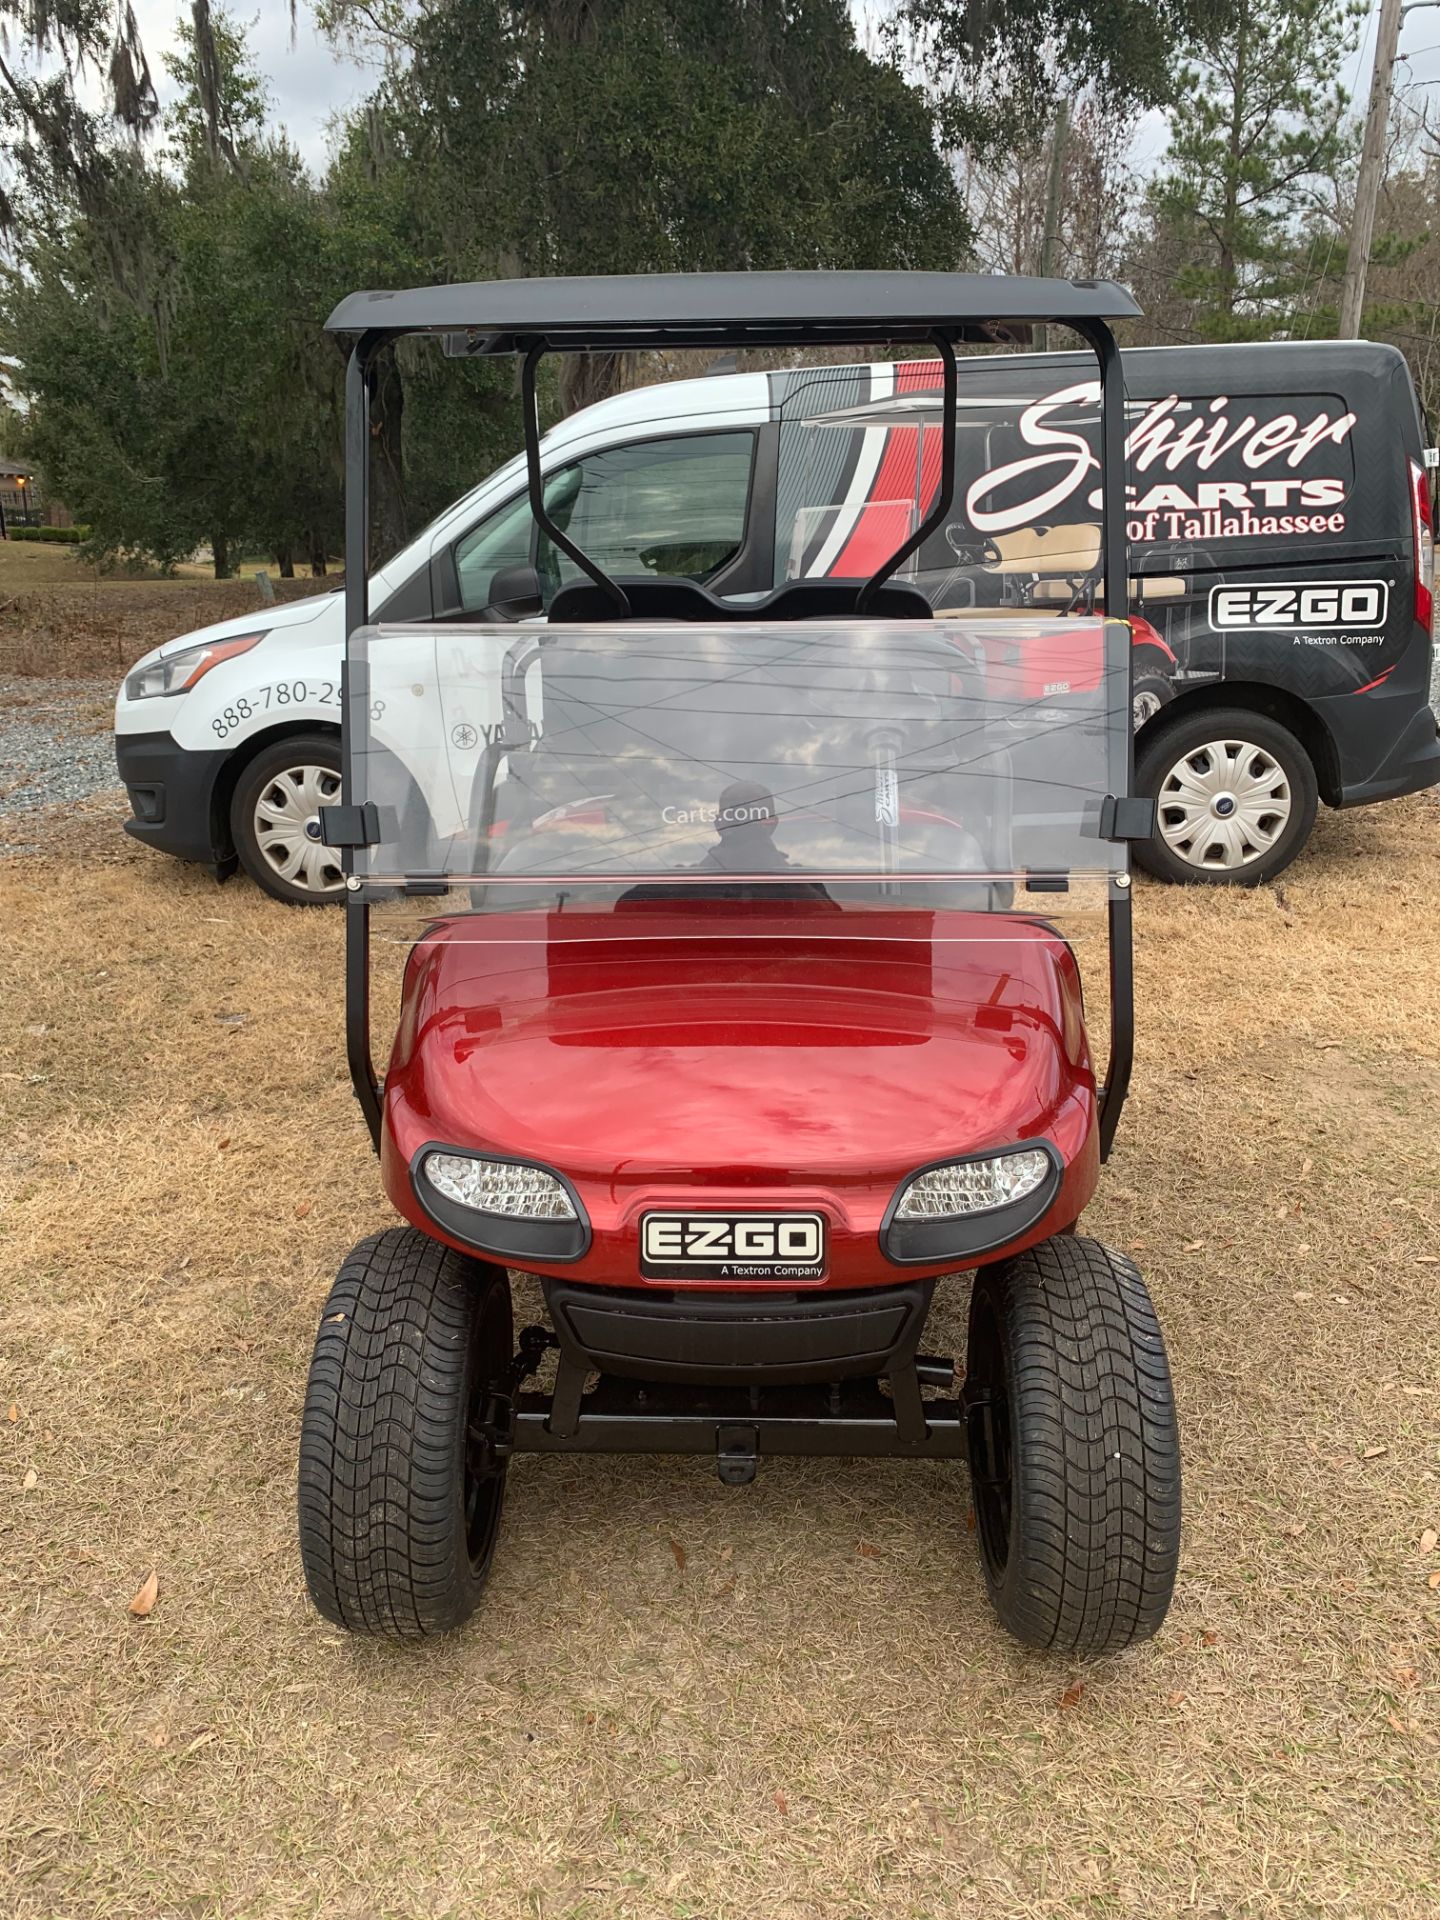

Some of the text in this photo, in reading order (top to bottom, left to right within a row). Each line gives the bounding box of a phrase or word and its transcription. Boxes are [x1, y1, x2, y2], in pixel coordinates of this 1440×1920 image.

[966, 381, 1357, 531] Shiver
[1126, 509, 1345, 541] of Tallahassee
[1293, 635, 1385, 650] A Textron Company
[212, 681, 386, 738] 888-780-28
[662, 806, 770, 824] Carts.com
[721, 1265, 823, 1277] A Textron Company
